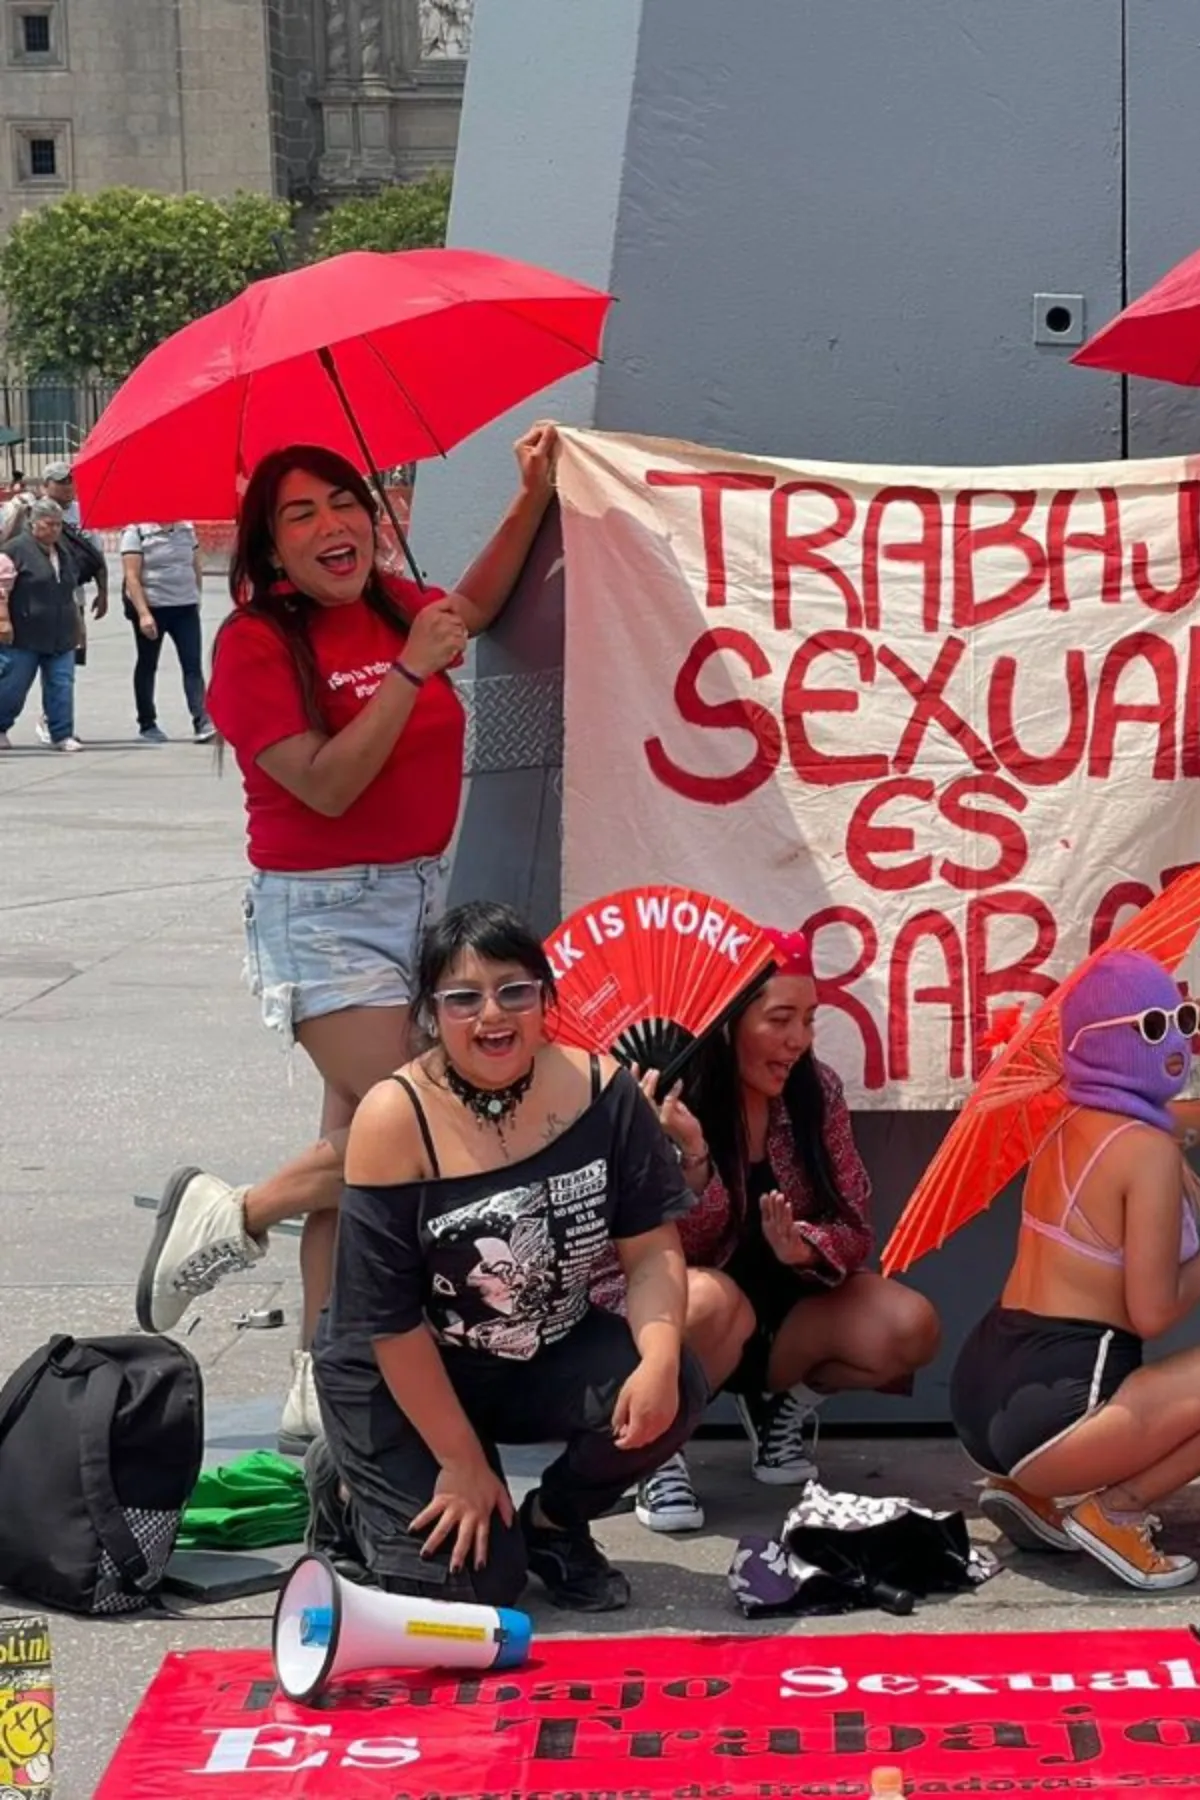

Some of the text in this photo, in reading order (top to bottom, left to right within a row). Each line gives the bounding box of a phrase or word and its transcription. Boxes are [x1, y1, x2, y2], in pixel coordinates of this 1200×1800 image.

[844, 772, 1028, 890] ES
[586, 905, 625, 946] IS
[635, 895, 751, 965] WORK
[186, 1722, 421, 1774] Es
[671, 1782, 735, 1799] de
[753, 1774, 1099, 1799] Trabjadoras
